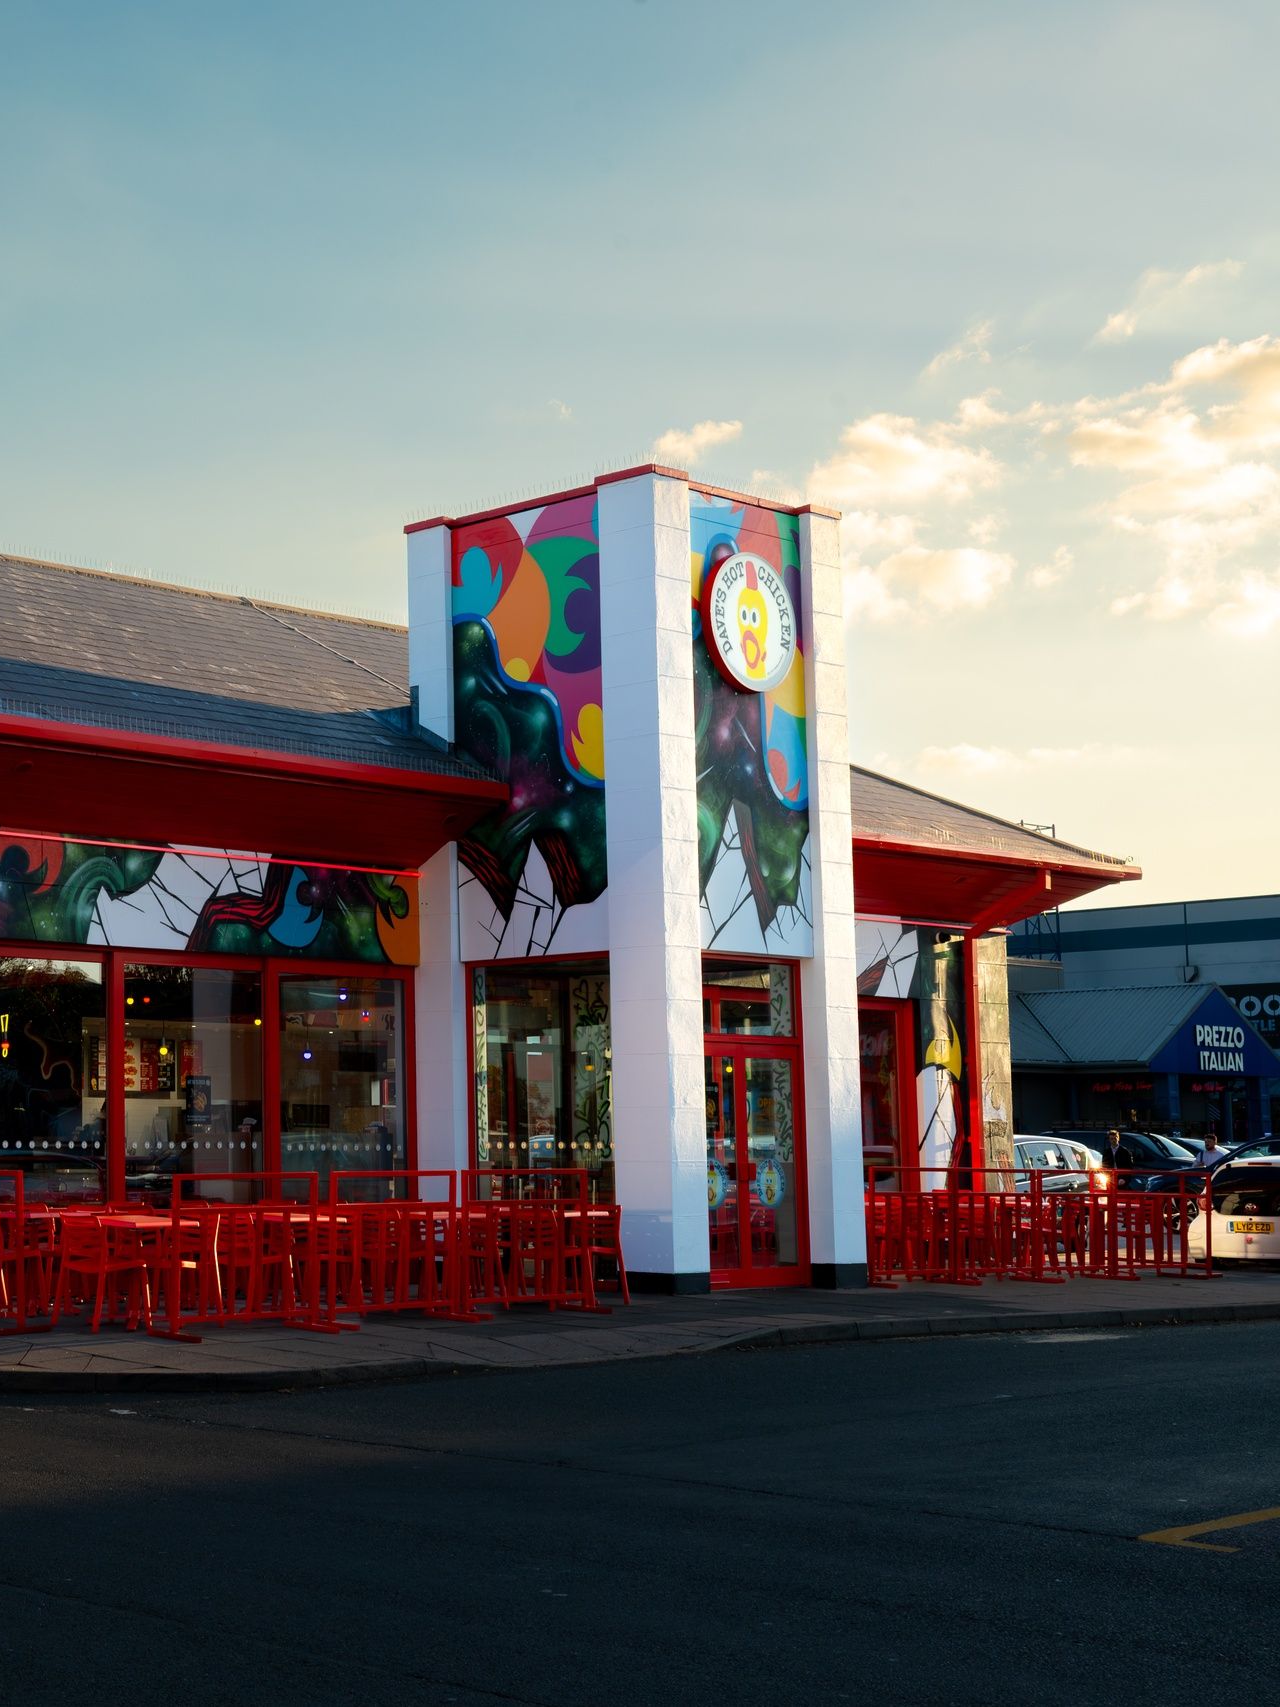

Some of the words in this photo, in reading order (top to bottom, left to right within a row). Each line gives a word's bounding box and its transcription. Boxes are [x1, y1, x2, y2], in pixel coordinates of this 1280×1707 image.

[722, 561, 744, 592] HOT
[715, 588, 733, 655] DAVE'S
[757, 566, 791, 652] CHICKEN
[1195, 1024, 1245, 1048] PREZZO
[1200, 1051, 1244, 1072] ITALIAN
[1236, 1223, 1254, 1232] LY12
